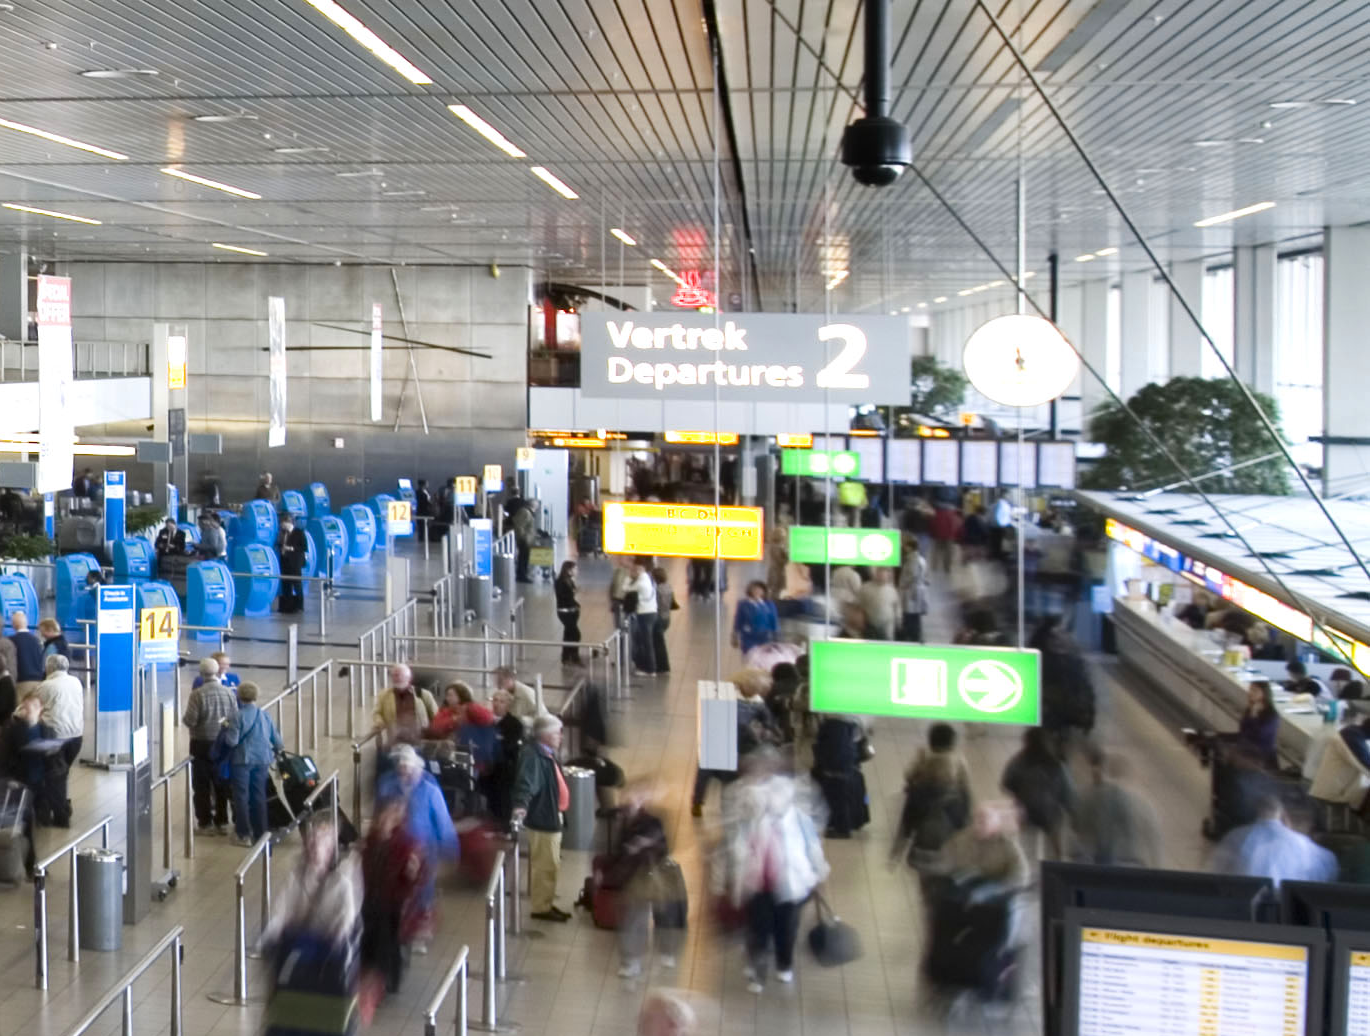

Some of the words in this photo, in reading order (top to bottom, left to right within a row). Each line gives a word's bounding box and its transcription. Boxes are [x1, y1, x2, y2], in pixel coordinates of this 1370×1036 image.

[606, 320, 748, 351] Vertrek
[816, 323, 870, 389] 2
[606, 356, 804, 390] Departures
[459, 478, 473, 492] 11
[391, 504, 407, 521] 12
[145, 610, 174, 639] 14
[1104, 932, 1140, 945] Flight
[1143, 935, 1210, 951] departures
